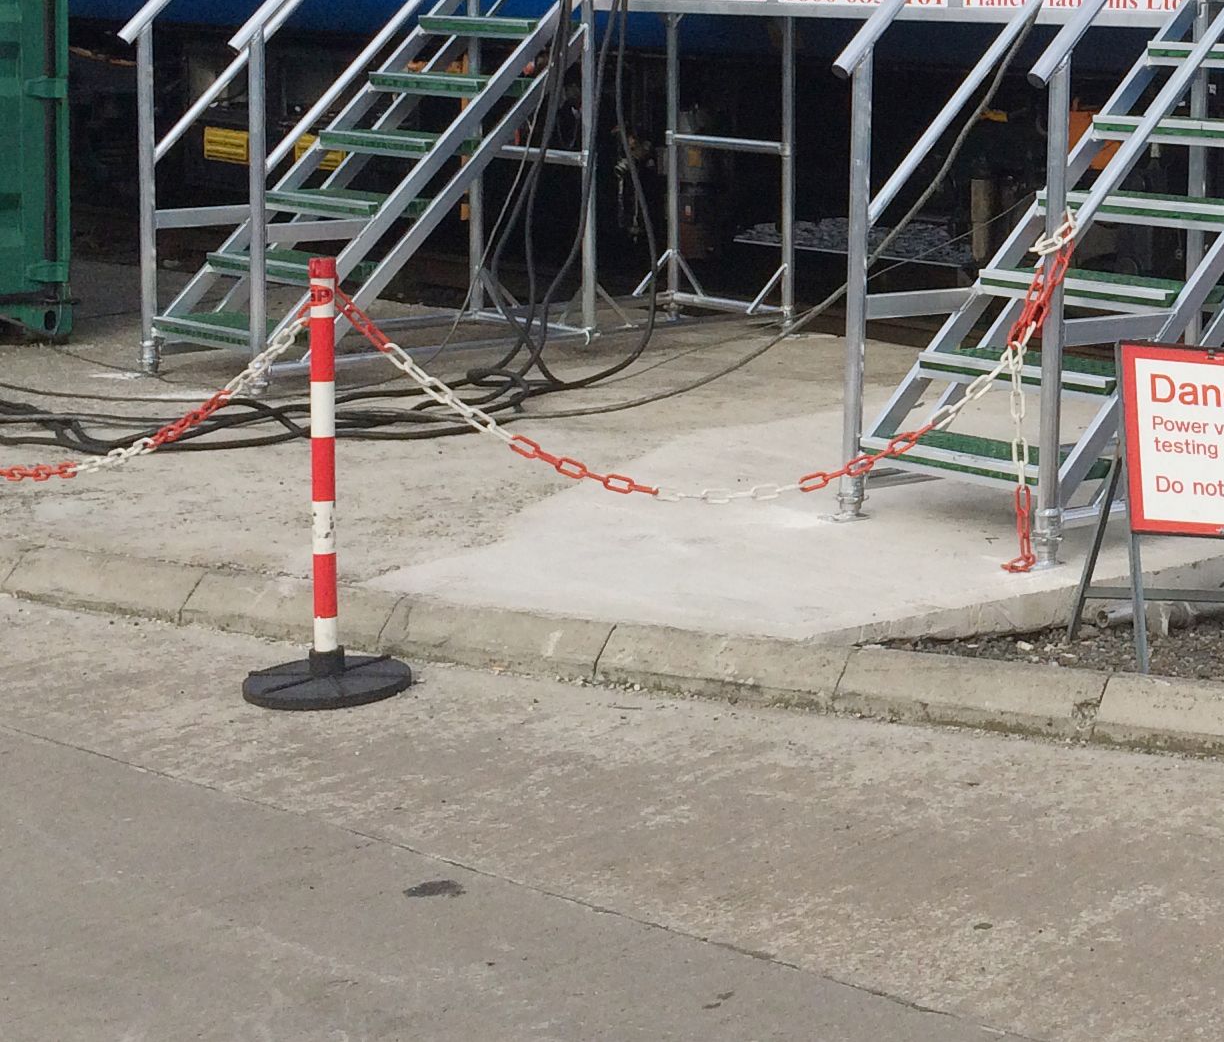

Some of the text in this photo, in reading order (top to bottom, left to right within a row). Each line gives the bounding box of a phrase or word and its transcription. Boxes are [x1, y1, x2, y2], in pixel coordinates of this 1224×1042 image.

[1152, 415, 1209, 434] Power
[1154, 436, 1219, 459] testing
[1155, 475, 1184, 494] Do
[1193, 480, 1224, 497] not
